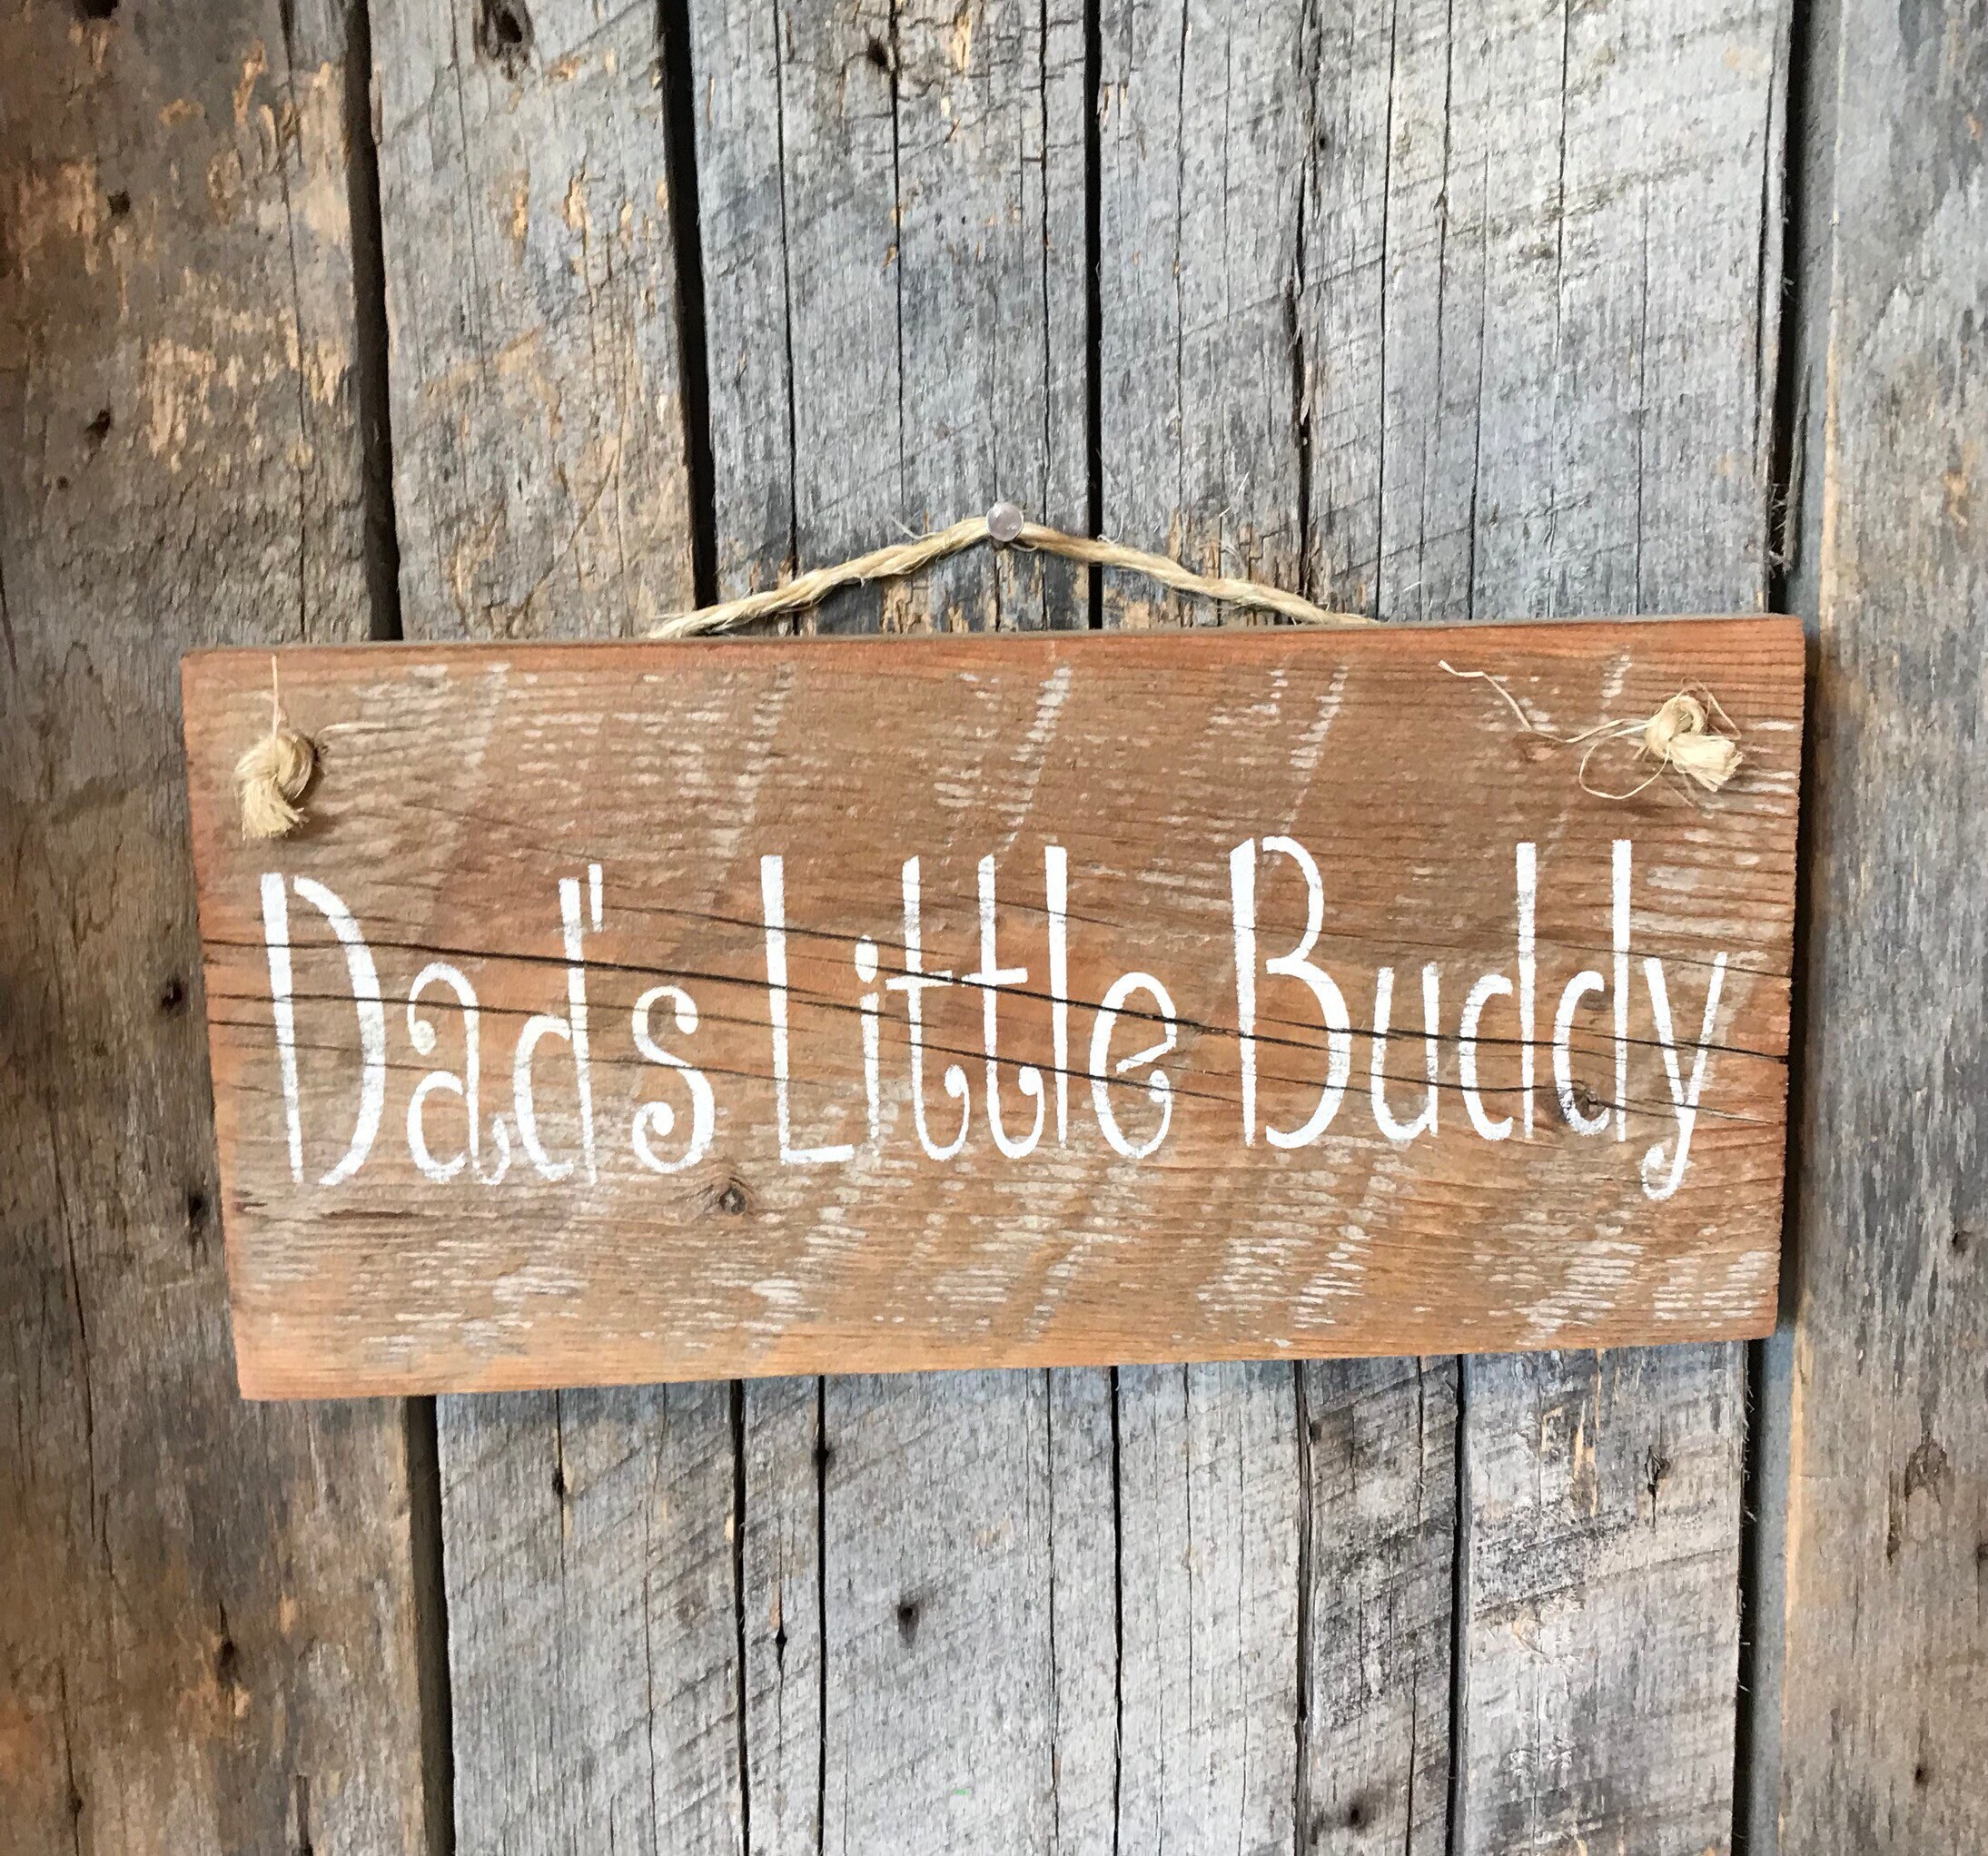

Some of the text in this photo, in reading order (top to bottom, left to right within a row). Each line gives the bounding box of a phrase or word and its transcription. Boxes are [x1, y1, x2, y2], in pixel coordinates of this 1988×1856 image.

[260, 835, 1727, 1201] Dad's Little Buddy
